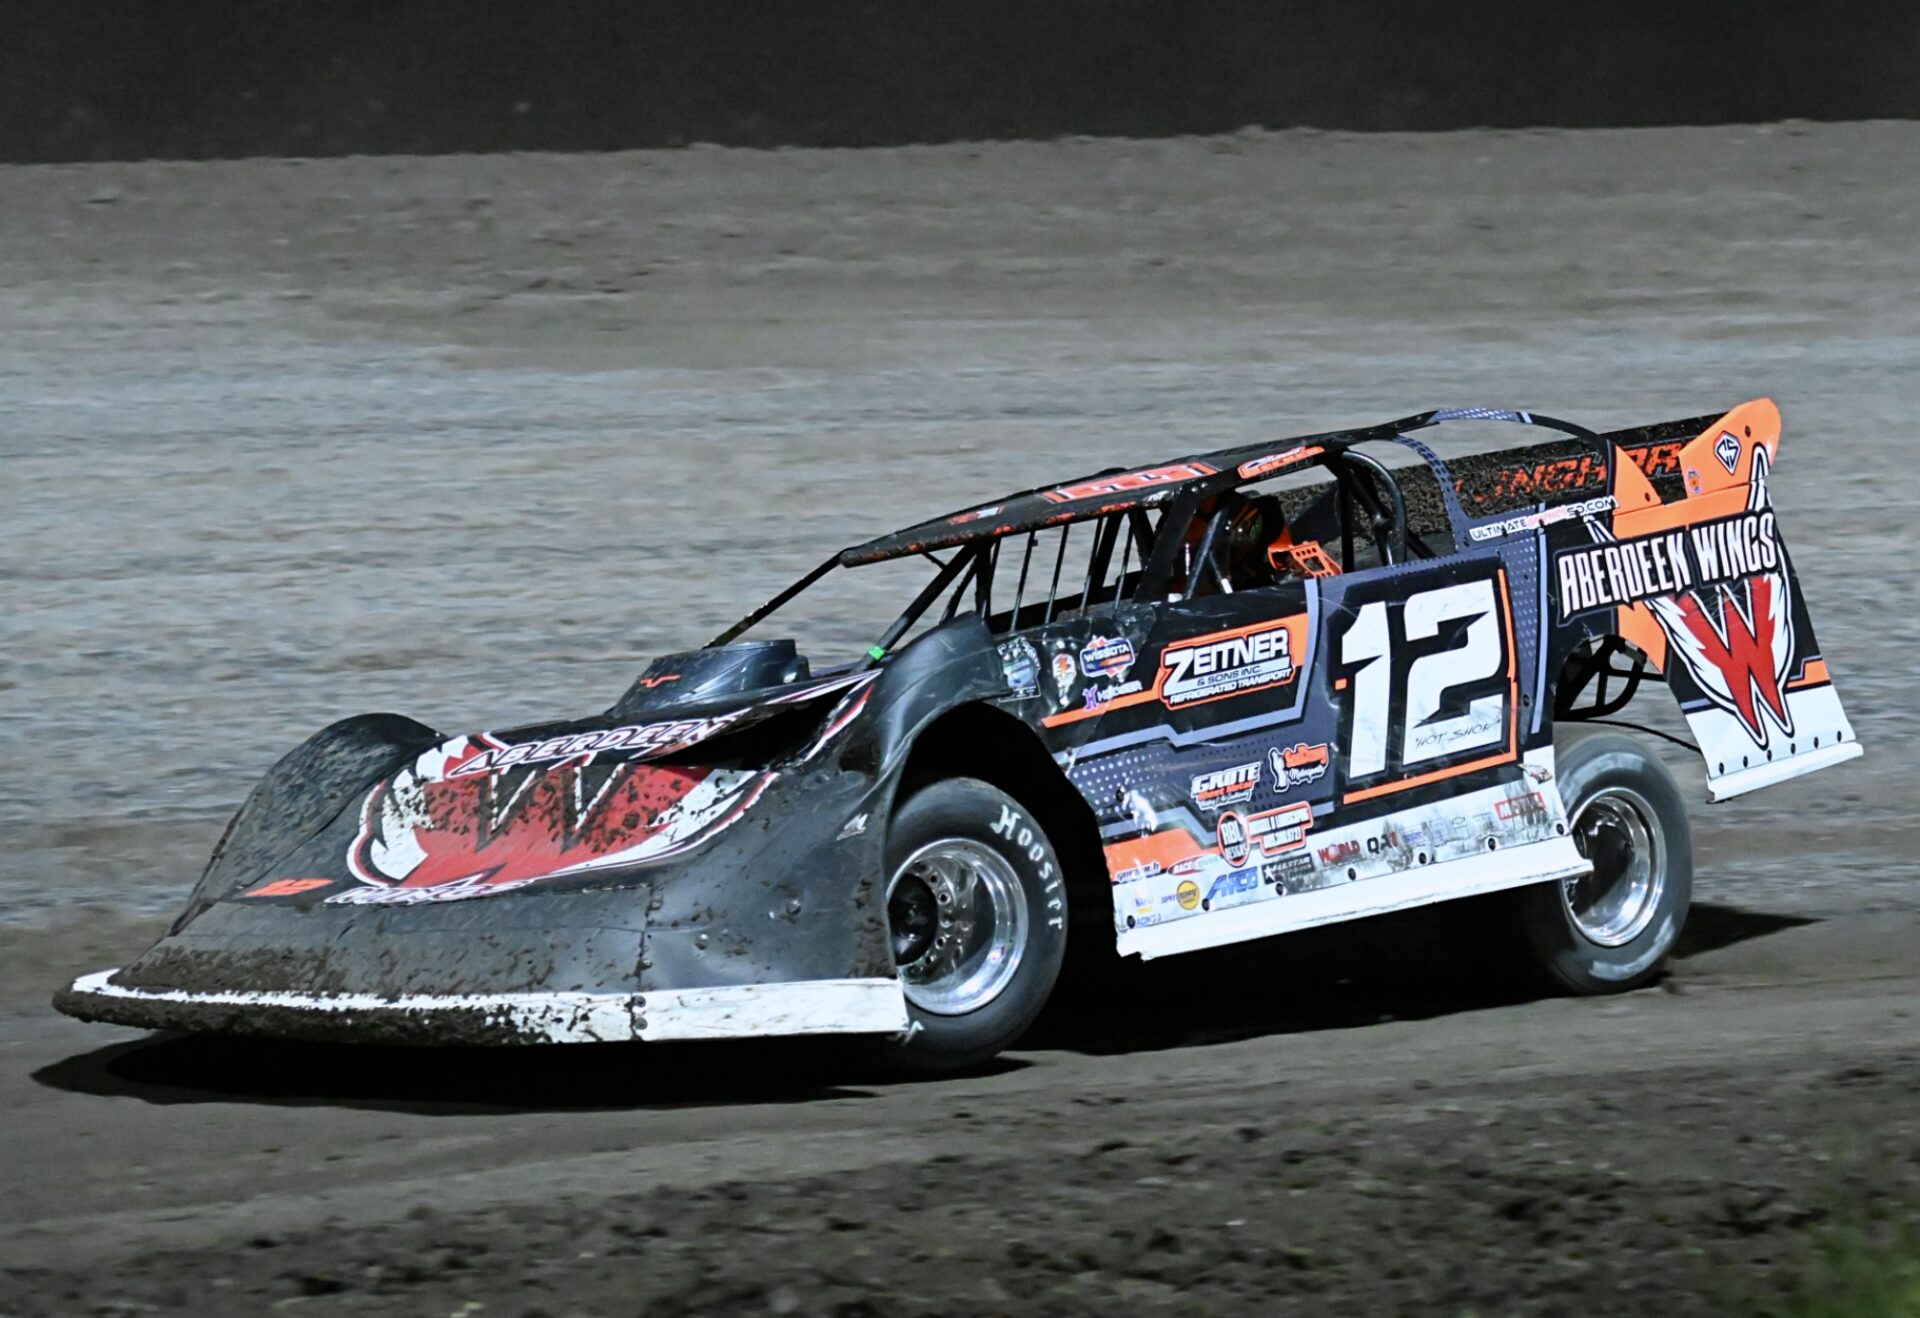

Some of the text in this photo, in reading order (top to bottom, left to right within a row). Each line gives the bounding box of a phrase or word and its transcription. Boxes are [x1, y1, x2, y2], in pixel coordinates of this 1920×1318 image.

[1558, 512, 1777, 619] ABERDEEN WINGS
[1083, 642, 1130, 662] WISSOTA
[1163, 628, 1290, 697] ZEITNER
[1197, 665, 1263, 687] & SONS INC.
[1341, 578, 1502, 779] 12
[1169, 668, 1293, 705] REFRIGERATED TRANSPORT
[450, 713, 742, 777] ABERDEEN
